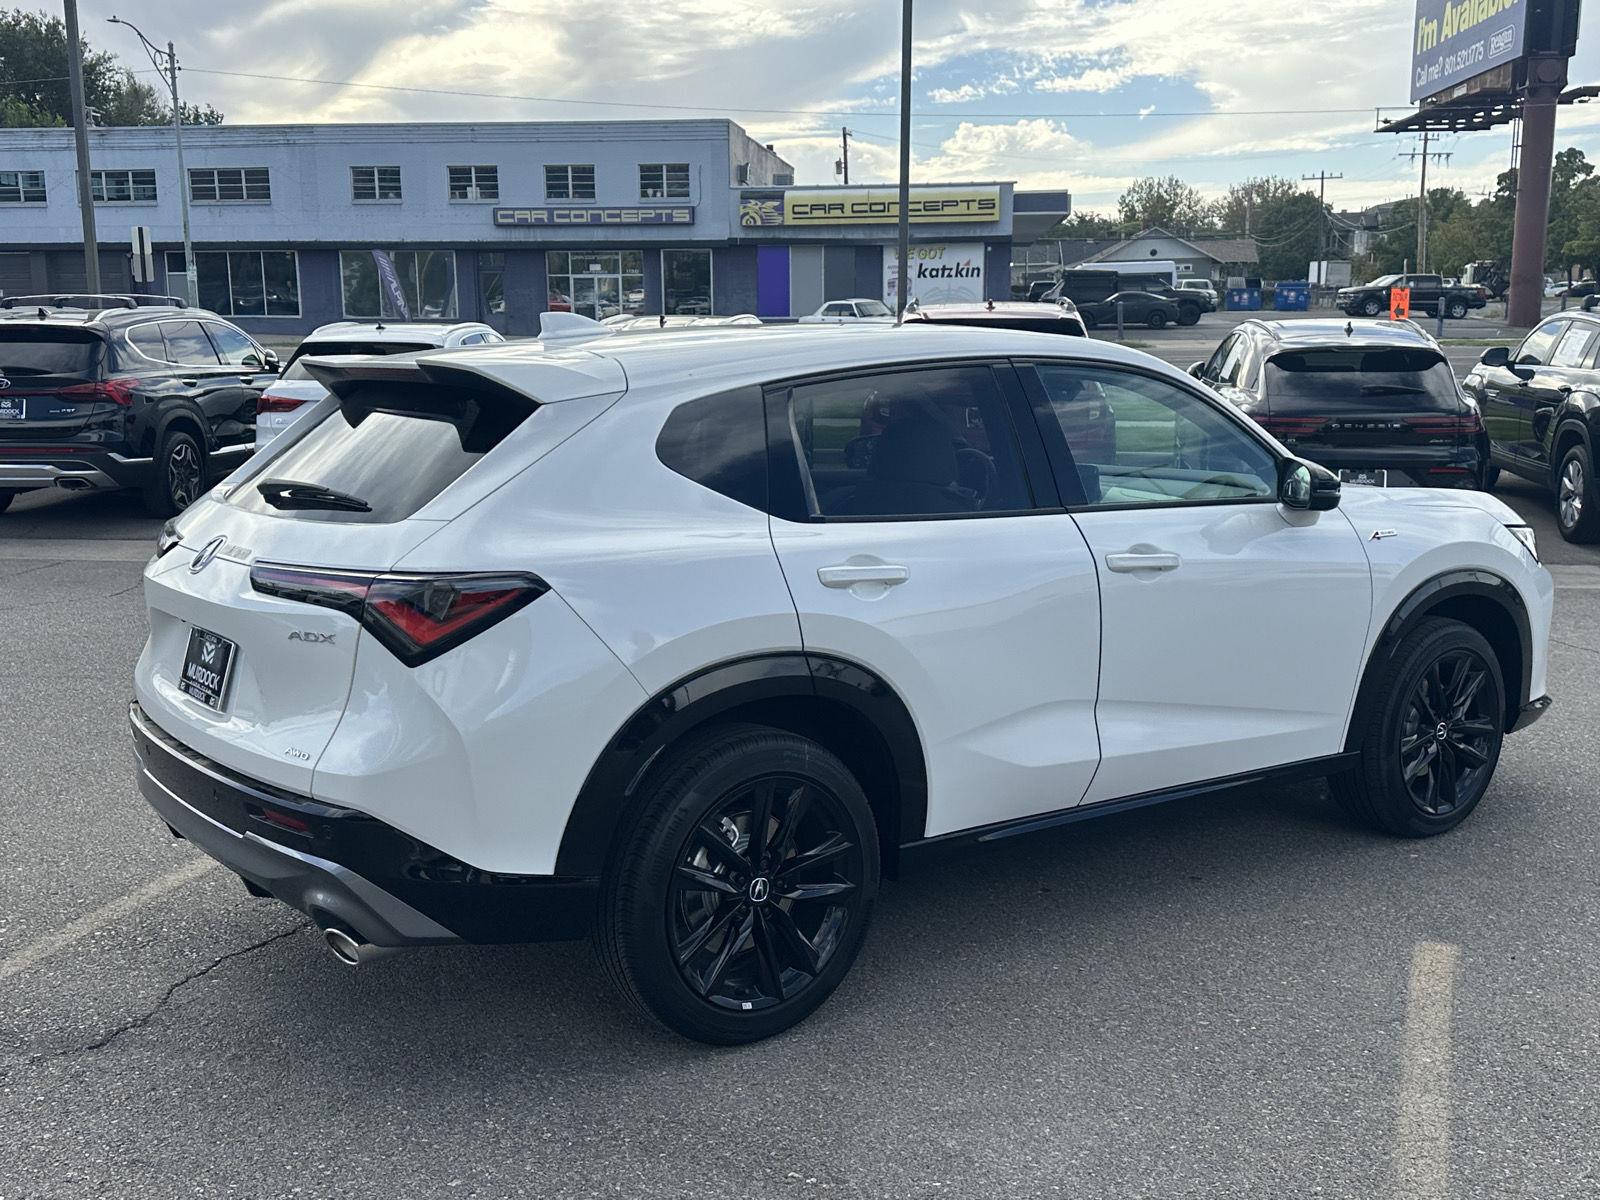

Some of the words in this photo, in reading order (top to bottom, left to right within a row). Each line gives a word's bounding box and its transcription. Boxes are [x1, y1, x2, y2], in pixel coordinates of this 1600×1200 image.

[1416, 16, 1438, 55] I'm
[1440, 0, 1519, 43] Availab
[1415, 63, 1428, 88] Call
[1428, 56, 1444, 82] me?
[792, 203, 844, 216] CAR
[851, 198, 996, 215] CONCEPTS
[497, 210, 548, 224] CAR
[553, 209, 690, 224] CONCEPTS
[917, 247, 946, 260] GOT
[917, 258, 980, 279] katzkin
[288, 630, 336, 645] ADX
[187, 662, 221, 690] MURDOCK
[284, 746, 310, 761] AWD
